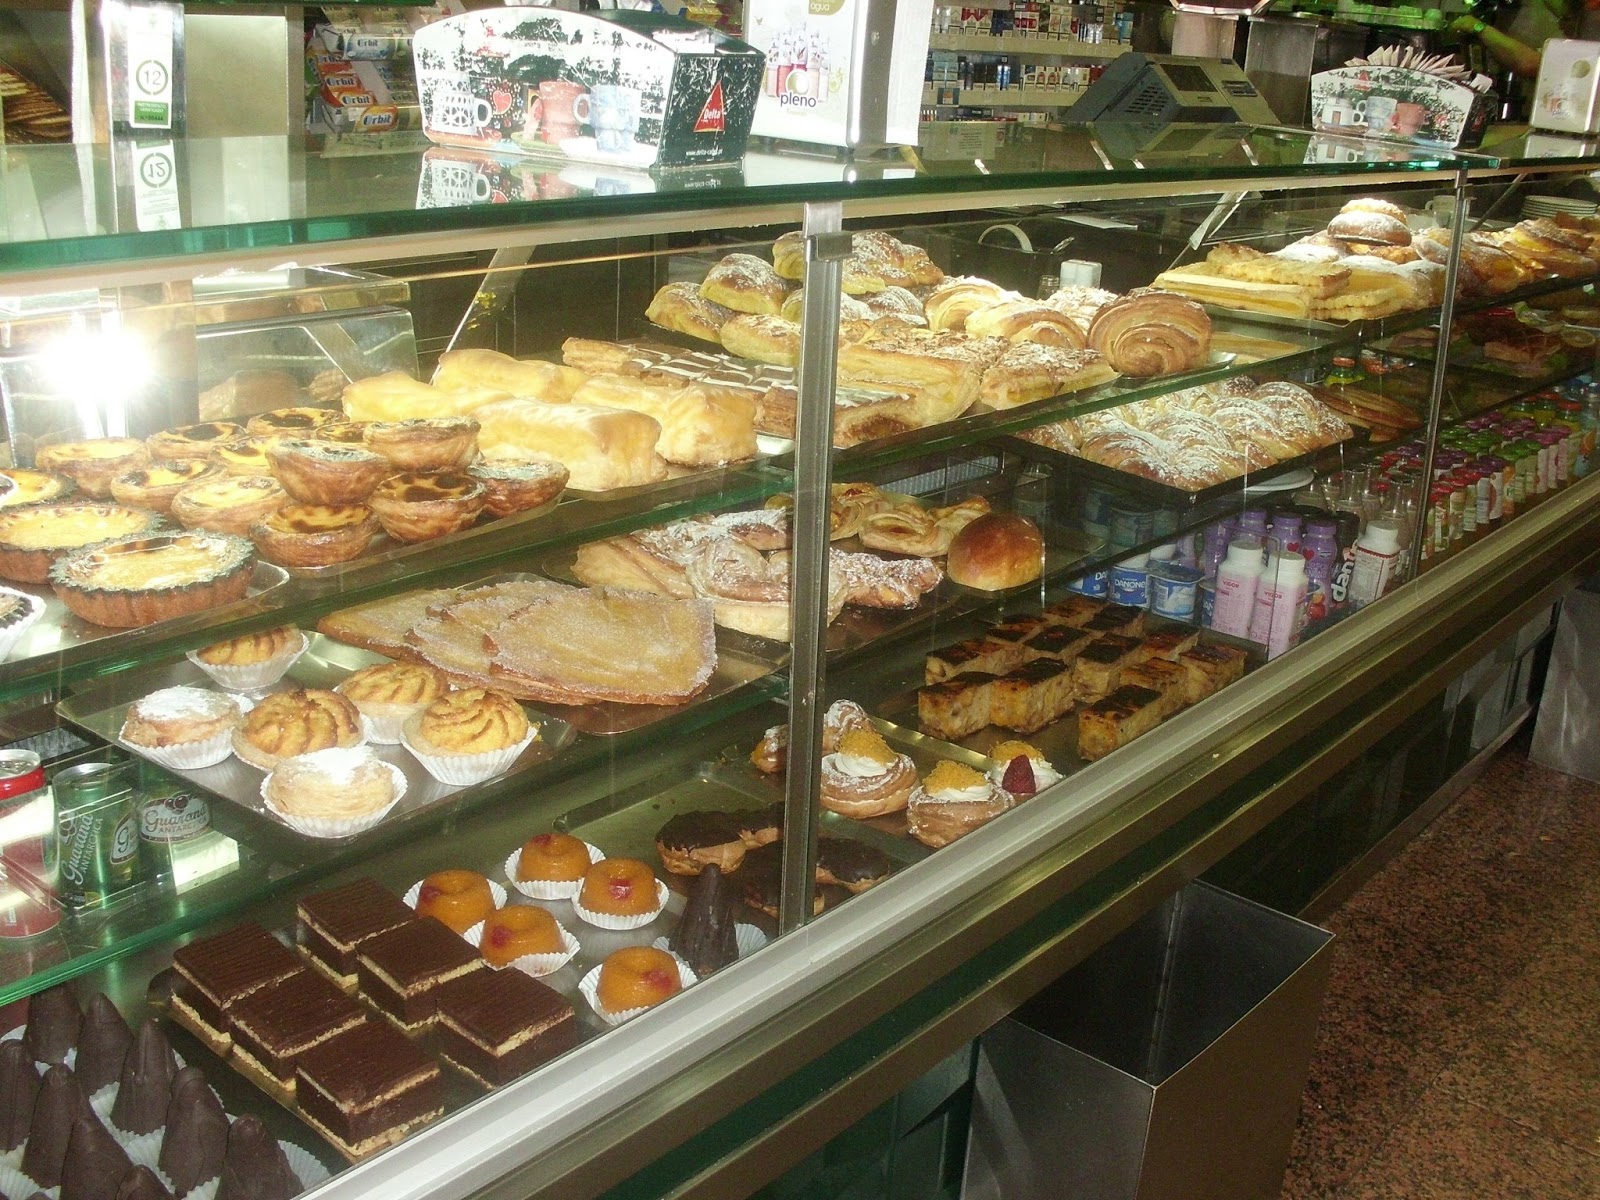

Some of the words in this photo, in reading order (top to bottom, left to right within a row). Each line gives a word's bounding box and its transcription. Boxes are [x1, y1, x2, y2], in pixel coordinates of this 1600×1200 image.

[357, 39, 379, 48] Orbit
[144, 69, 162, 86] 12
[326, 76, 355, 87] Orbit
[341, 94, 371, 105] Orbit
[780, 92, 817, 108] pleno
[363, 113, 392, 126] Orbit
[703, 108, 721, 120] Delta
[1114, 579, 1146, 589] DANONE
[1222, 580, 1240, 588] VIGOR
